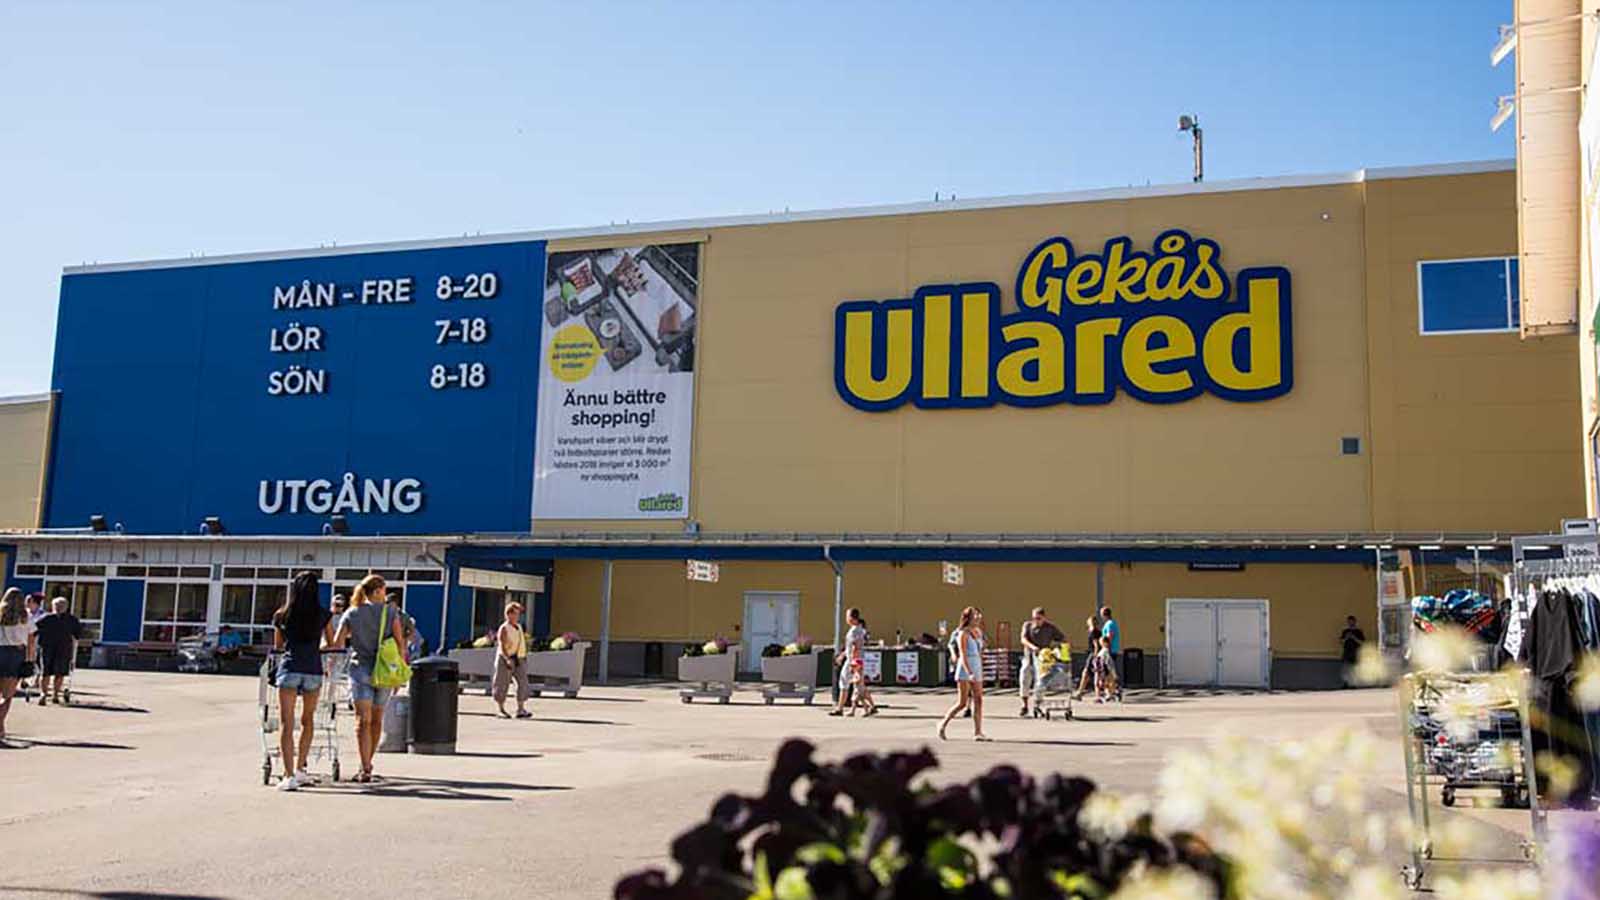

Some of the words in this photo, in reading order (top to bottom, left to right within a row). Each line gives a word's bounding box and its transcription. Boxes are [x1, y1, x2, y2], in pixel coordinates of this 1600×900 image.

[273, 279, 335, 310] MÅN
[361, 277, 412, 305] FRE
[436, 273, 497, 300] 8-20
[1022, 234, 1225, 314] Gekås
[270, 322, 322, 352] LÖR
[435, 317, 487, 345] 7-18
[844, 277, 1282, 402] Ullared
[267, 365, 325, 395] SÖN
[430, 362, 486, 389] 8-18
[563, 388, 609, 407] Ännu
[613, 388, 667, 405] bättre
[571, 407, 656, 429] shopping!
[258, 471, 423, 514] UTGÅNG
